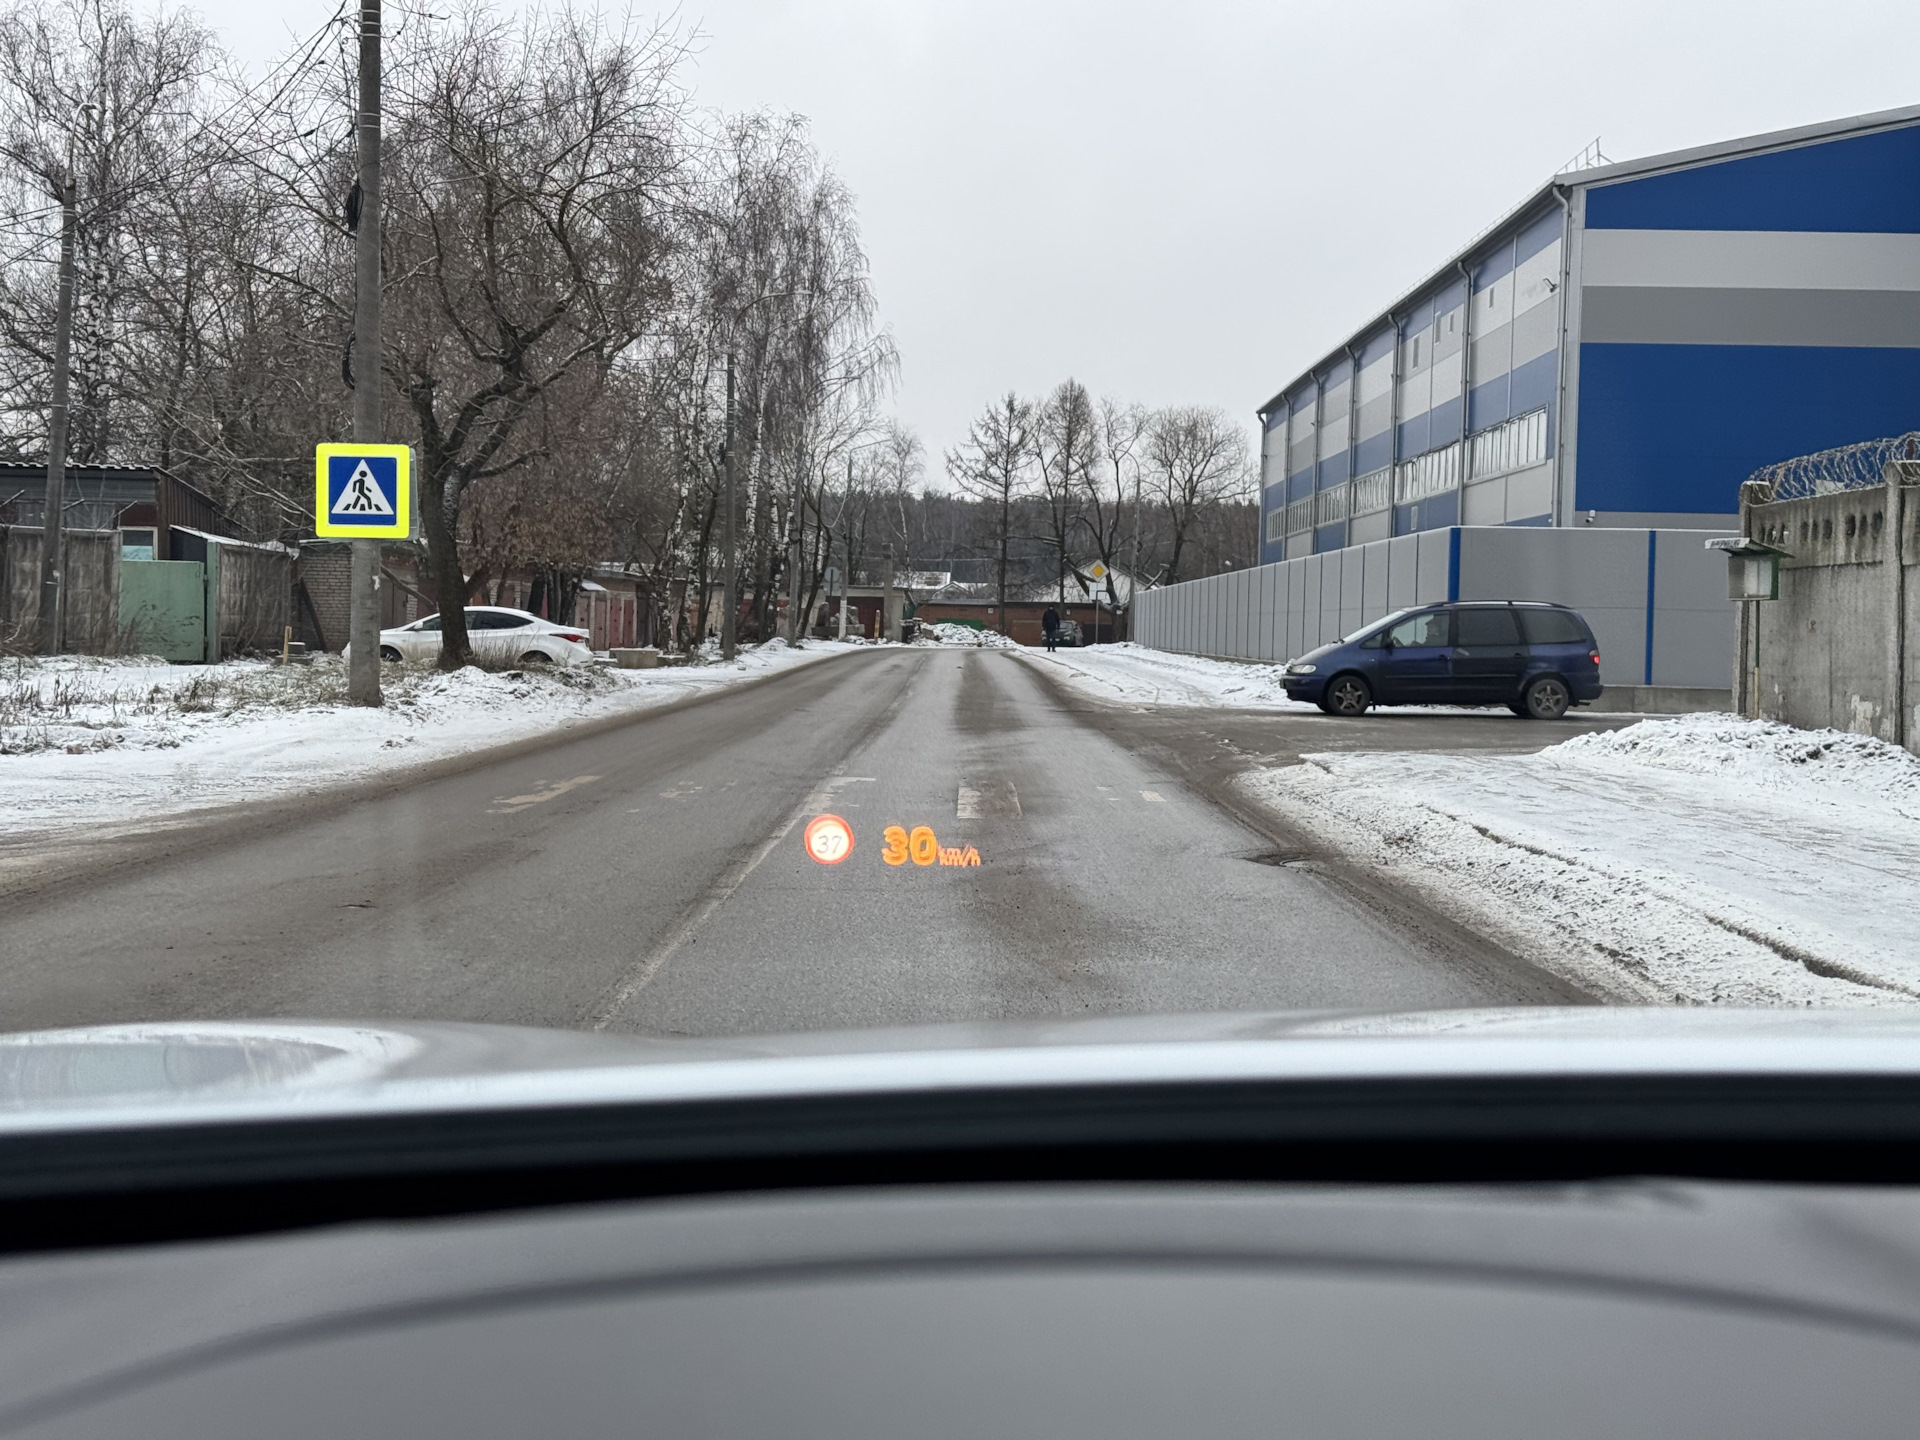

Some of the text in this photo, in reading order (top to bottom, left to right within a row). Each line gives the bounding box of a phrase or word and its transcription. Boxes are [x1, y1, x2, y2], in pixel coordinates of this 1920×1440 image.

[816, 834, 843, 854] 37
[881, 825, 981, 867] 30 km/h
